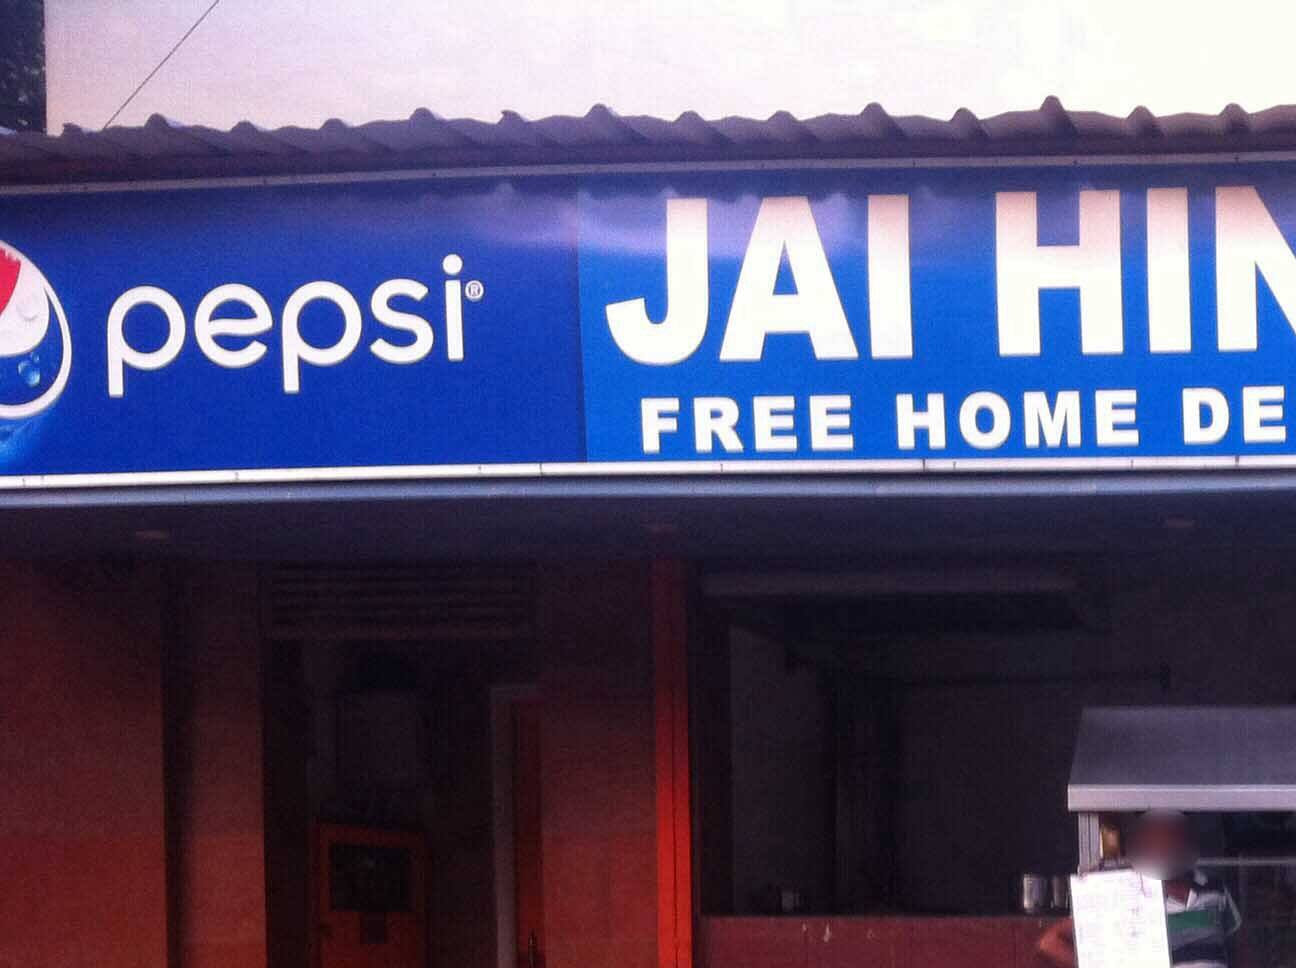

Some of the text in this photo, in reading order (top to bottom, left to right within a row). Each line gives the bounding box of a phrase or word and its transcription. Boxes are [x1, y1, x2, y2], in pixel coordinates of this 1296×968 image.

[107, 254, 464, 397] pepsi
[605, 194, 913, 366] JAI
[640, 394, 854, 453] FREE
[895, 388, 1139, 449] HOME
